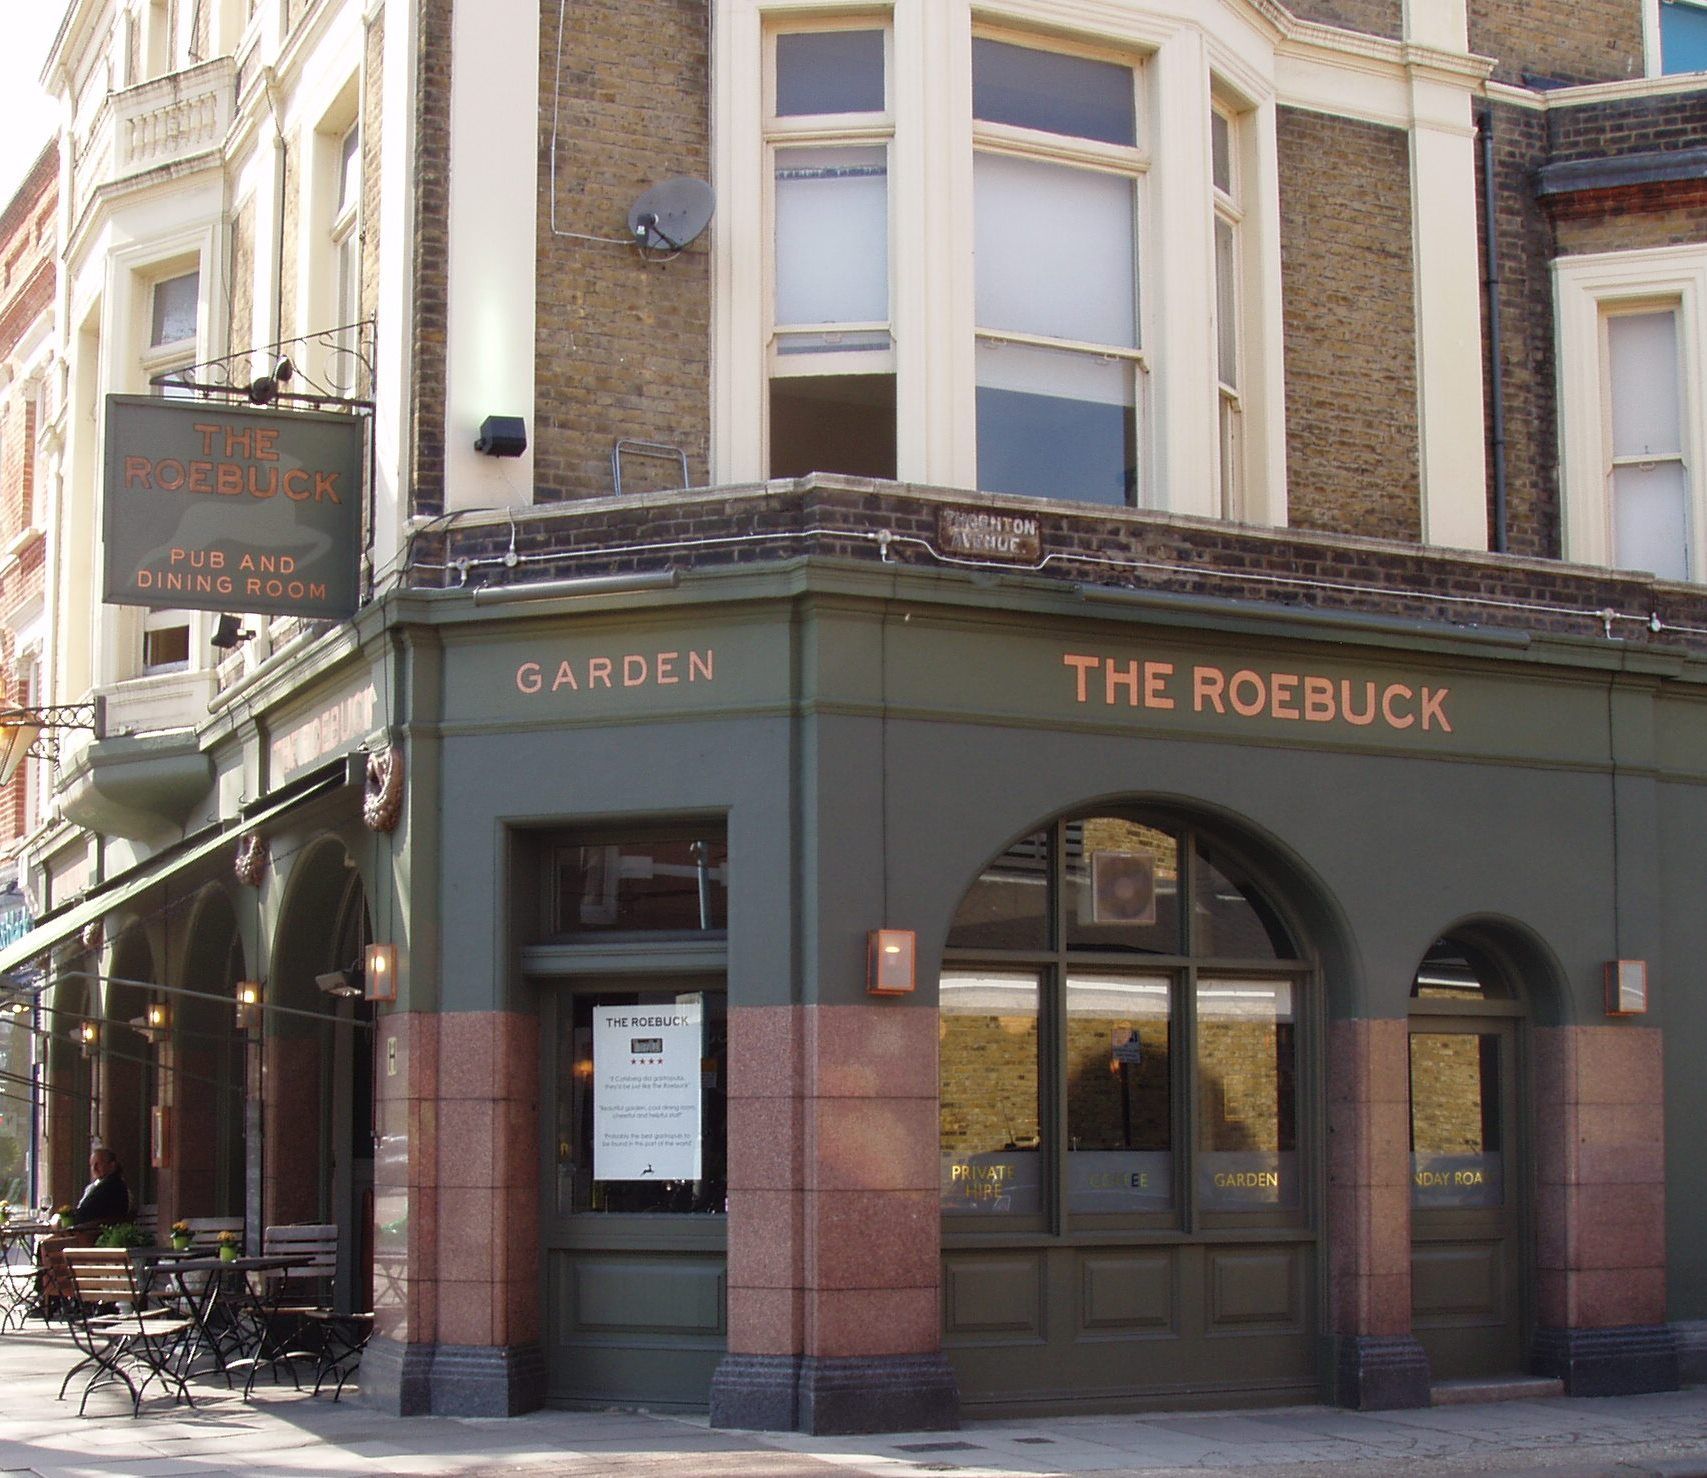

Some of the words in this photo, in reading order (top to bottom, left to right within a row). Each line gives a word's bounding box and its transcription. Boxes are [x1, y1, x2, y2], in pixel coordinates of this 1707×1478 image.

[193, 423, 281, 460] THE
[124, 455, 342, 503] ROEBUCK
[171, 548, 225, 568] PUB
[240, 553, 295, 574] AND
[138, 570, 233, 594] DINING
[246, 578, 326, 599] ROOM
[515, 650, 715, 695] GARDEN
[1063, 653, 1175, 709] THE
[1193, 665, 1453, 734] ROEBUCK
[606, 1018, 628, 1028] THE
[631, 1016, 689, 1027] ROEBUCK
[950, 1165, 1015, 1181] PRIVATE
[1215, 1171, 1279, 1187] GARDEN
[1455, 1171, 1484, 1186] ROA
[964, 1183, 1003, 1201] HIRE
